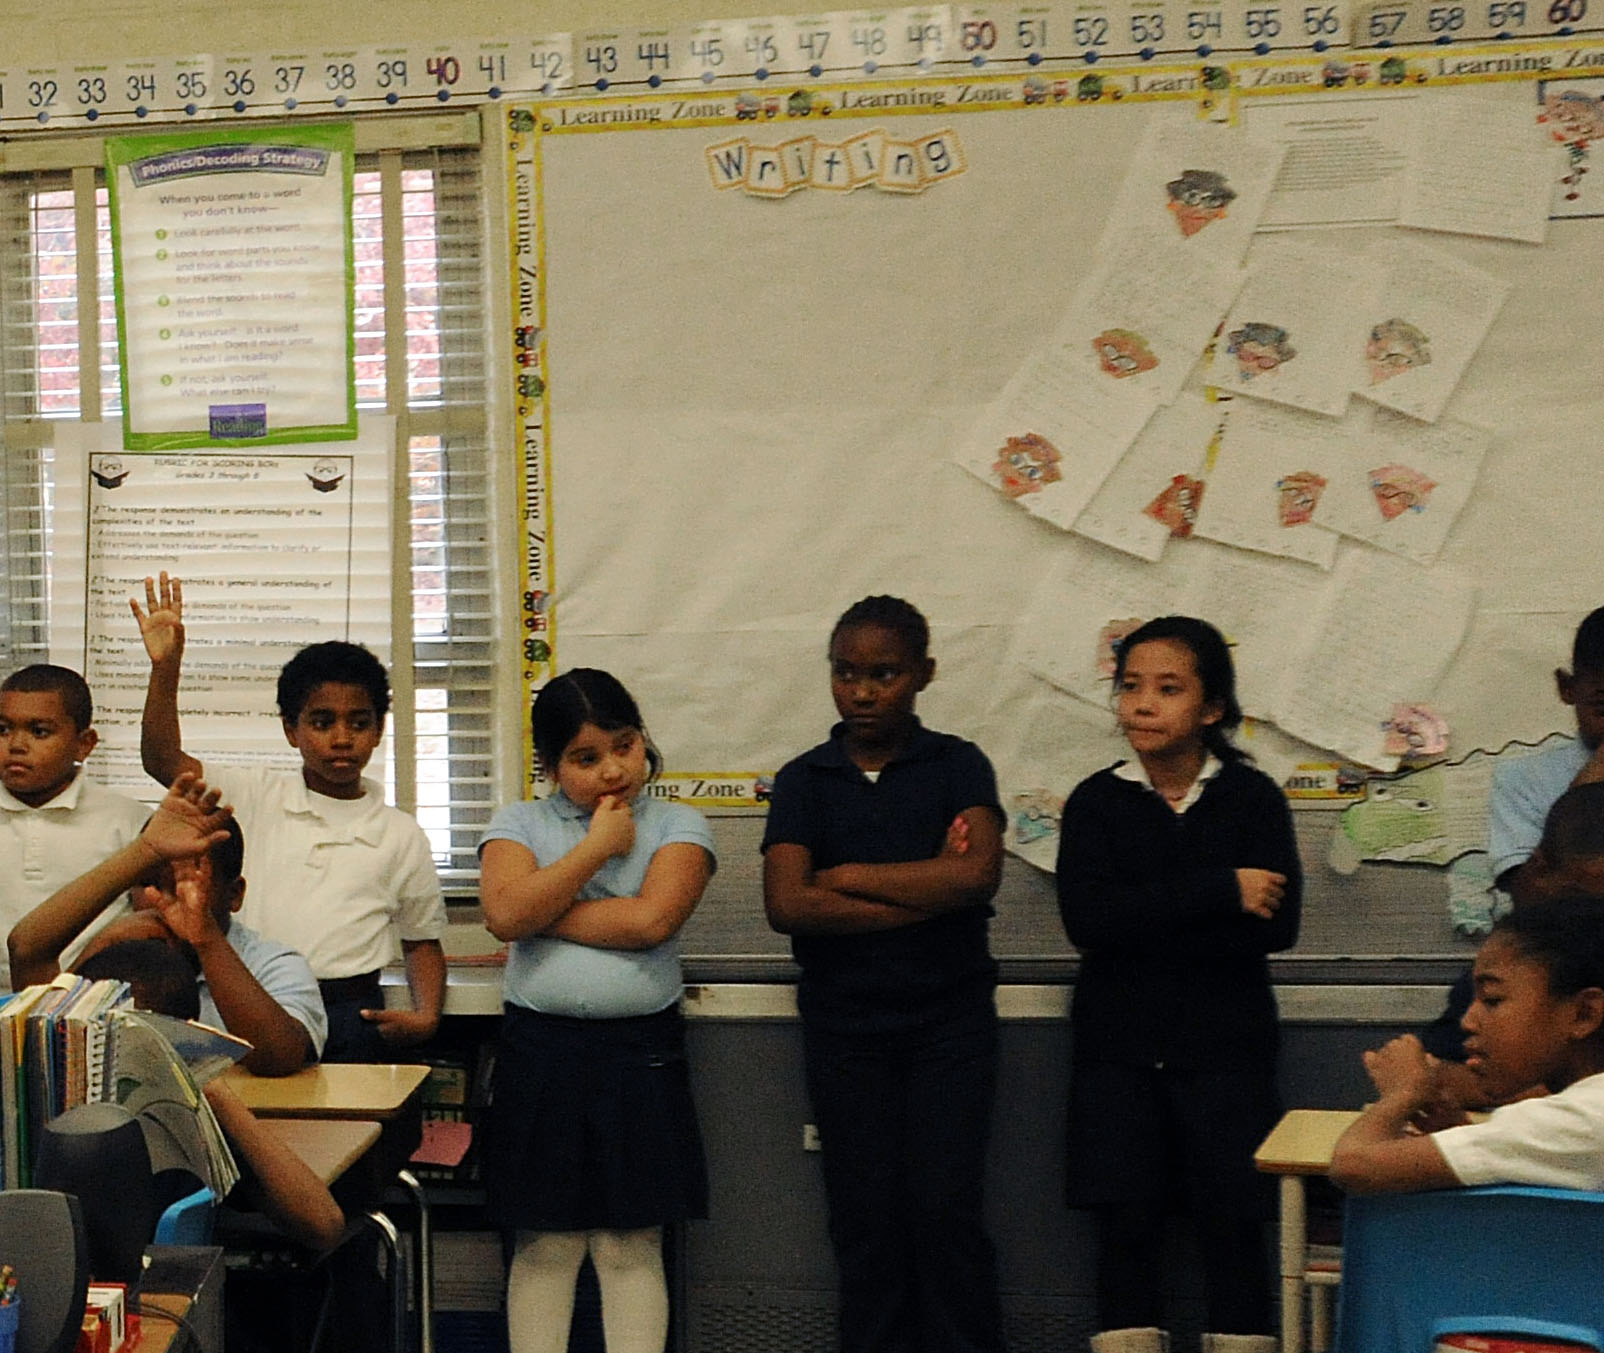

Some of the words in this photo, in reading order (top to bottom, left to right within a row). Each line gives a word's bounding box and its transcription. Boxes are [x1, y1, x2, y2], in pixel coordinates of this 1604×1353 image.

[28, 80, 58, 108] 32
[77, 77, 107, 105] 33
[126, 74, 156, 102] 34
[175, 71, 207, 100] 35
[223, 69, 256, 97] 36
[274, 65, 306, 93] 37
[325, 62, 357, 91] 38
[376, 60, 408, 89] 39
[426, 56, 460, 86] 40
[478, 54, 506, 83] 41
[529, 51, 564, 80] 42
[586, 46, 618, 74] 43
[637, 42, 670, 71] 44
[688, 39, 725, 67] 45
[744, 35, 779, 64] 46
[798, 32, 831, 61] 47
[852, 28, 887, 56] 48
[907, 24, 939, 54] 49
[961, 21, 998, 52] 50
[1017, 20, 1046, 49] 51
[1073, 17, 1108, 47] 52
[1132, 14, 1165, 44] 53
[1187, 12, 1222, 41] 54
[1245, 9, 1281, 39] 55
[1303, 7, 1339, 36] 56
[1368, 11, 1407, 38] 57
[1427, 6, 1465, 33] 58
[1488, 0, 1526, 29] 59
[1547, 0, 1587, 25] 60
[559, 104, 662, 128] Learning
[671, 99, 726, 121] Zone
[839, 89, 945, 112] Learning
[955, 83, 1013, 104] Zone
[1253, 67, 1313, 88] Zone
[1436, 51, 1552, 78] Learning
[142, 152, 259, 177] Phonics/Decoding
[263, 153, 321, 169] Strategy
[714, 138, 952, 182] Writing
[159, 195, 191, 204] When
[194, 194, 215, 204] you
[217, 192, 245, 202] come
[248, 191, 261, 199] to
[273, 188, 301, 198] word
[183, 208, 203, 219] you
[205, 206, 234, 217] don't
[516, 158, 534, 256] Learning
[519, 265, 537, 317] Zone
[524, 424, 543, 521] Learning
[528, 530, 546, 583] Zone
[691, 779, 745, 798] Zone
